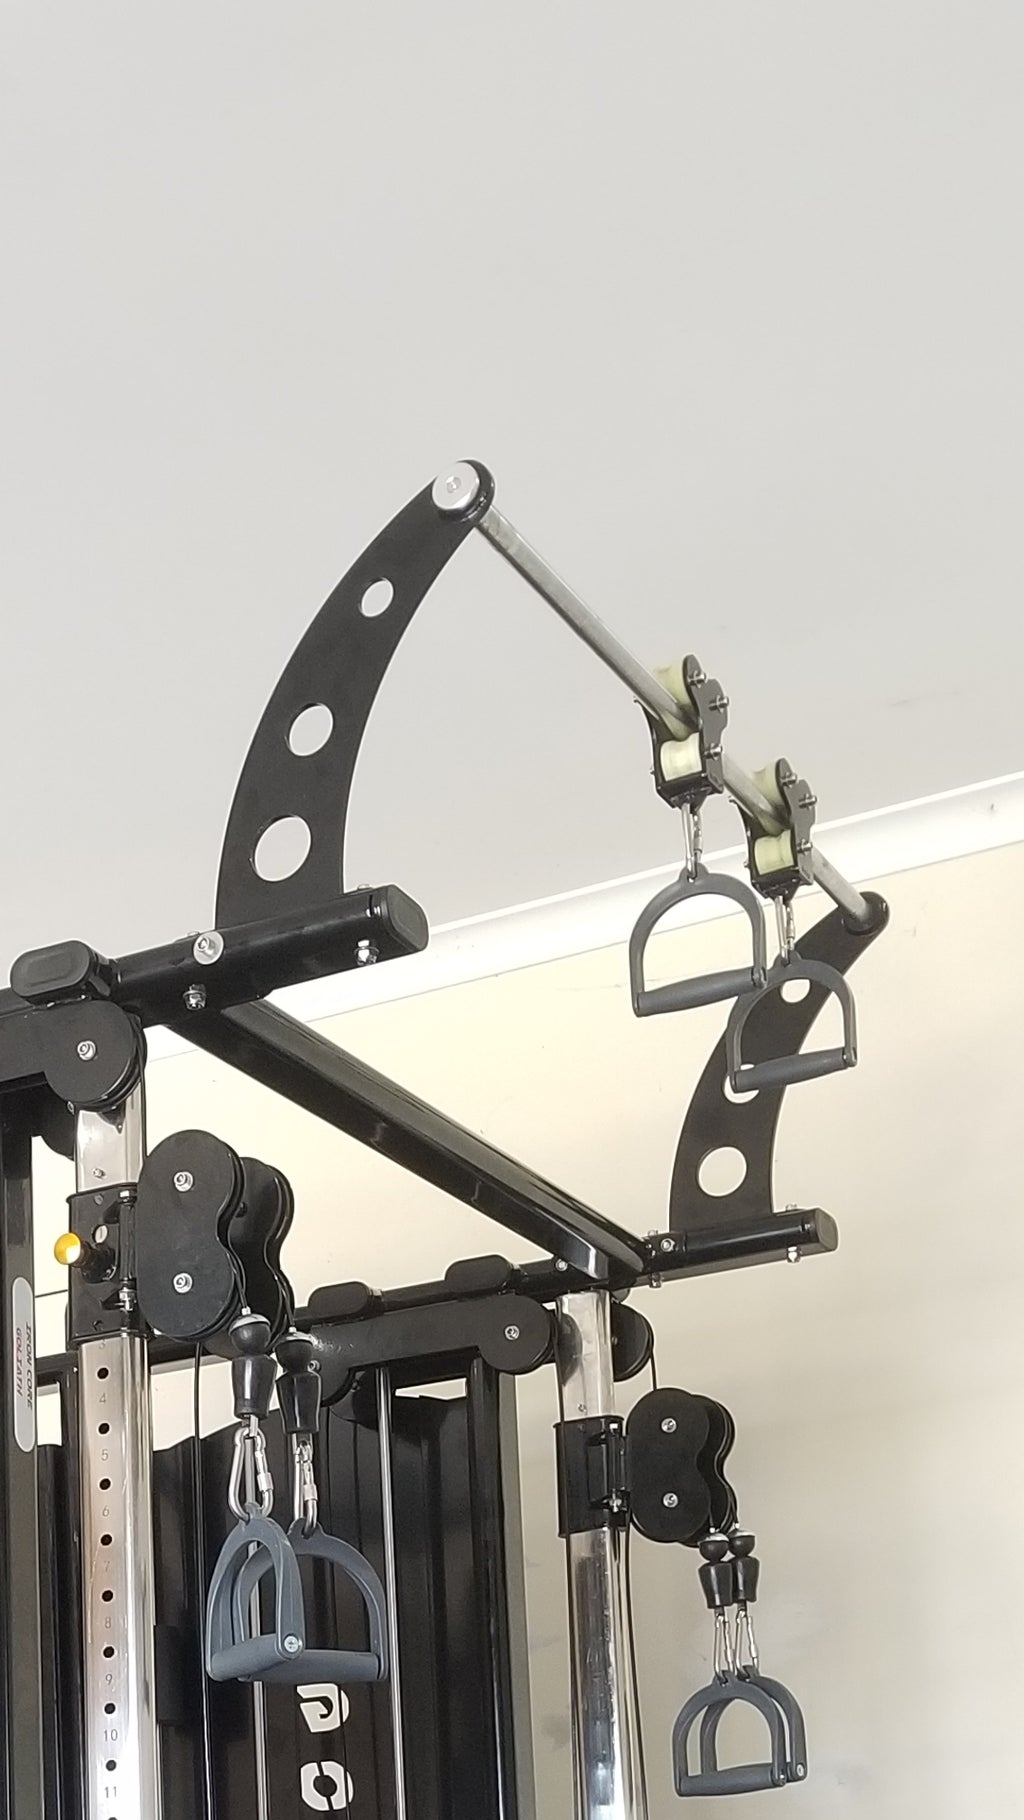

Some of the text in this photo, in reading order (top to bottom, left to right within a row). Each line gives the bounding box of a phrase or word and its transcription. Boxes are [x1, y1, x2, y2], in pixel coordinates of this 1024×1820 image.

[15, 1327, 24, 1397] GOLIATH
[26, 1369, 34, 1411] CORE
[99, 1393, 107, 1404] 4
[101, 1449, 109, 1461] 5
[102, 1505, 110, 1517] 6
[104, 1560, 111, 1572] 7
[104, 1616, 112, 1629] 8
[105, 1673, 113, 1686] 9
[103, 1729, 118, 1741] 10
[104, 1786, 117, 1798] 11
